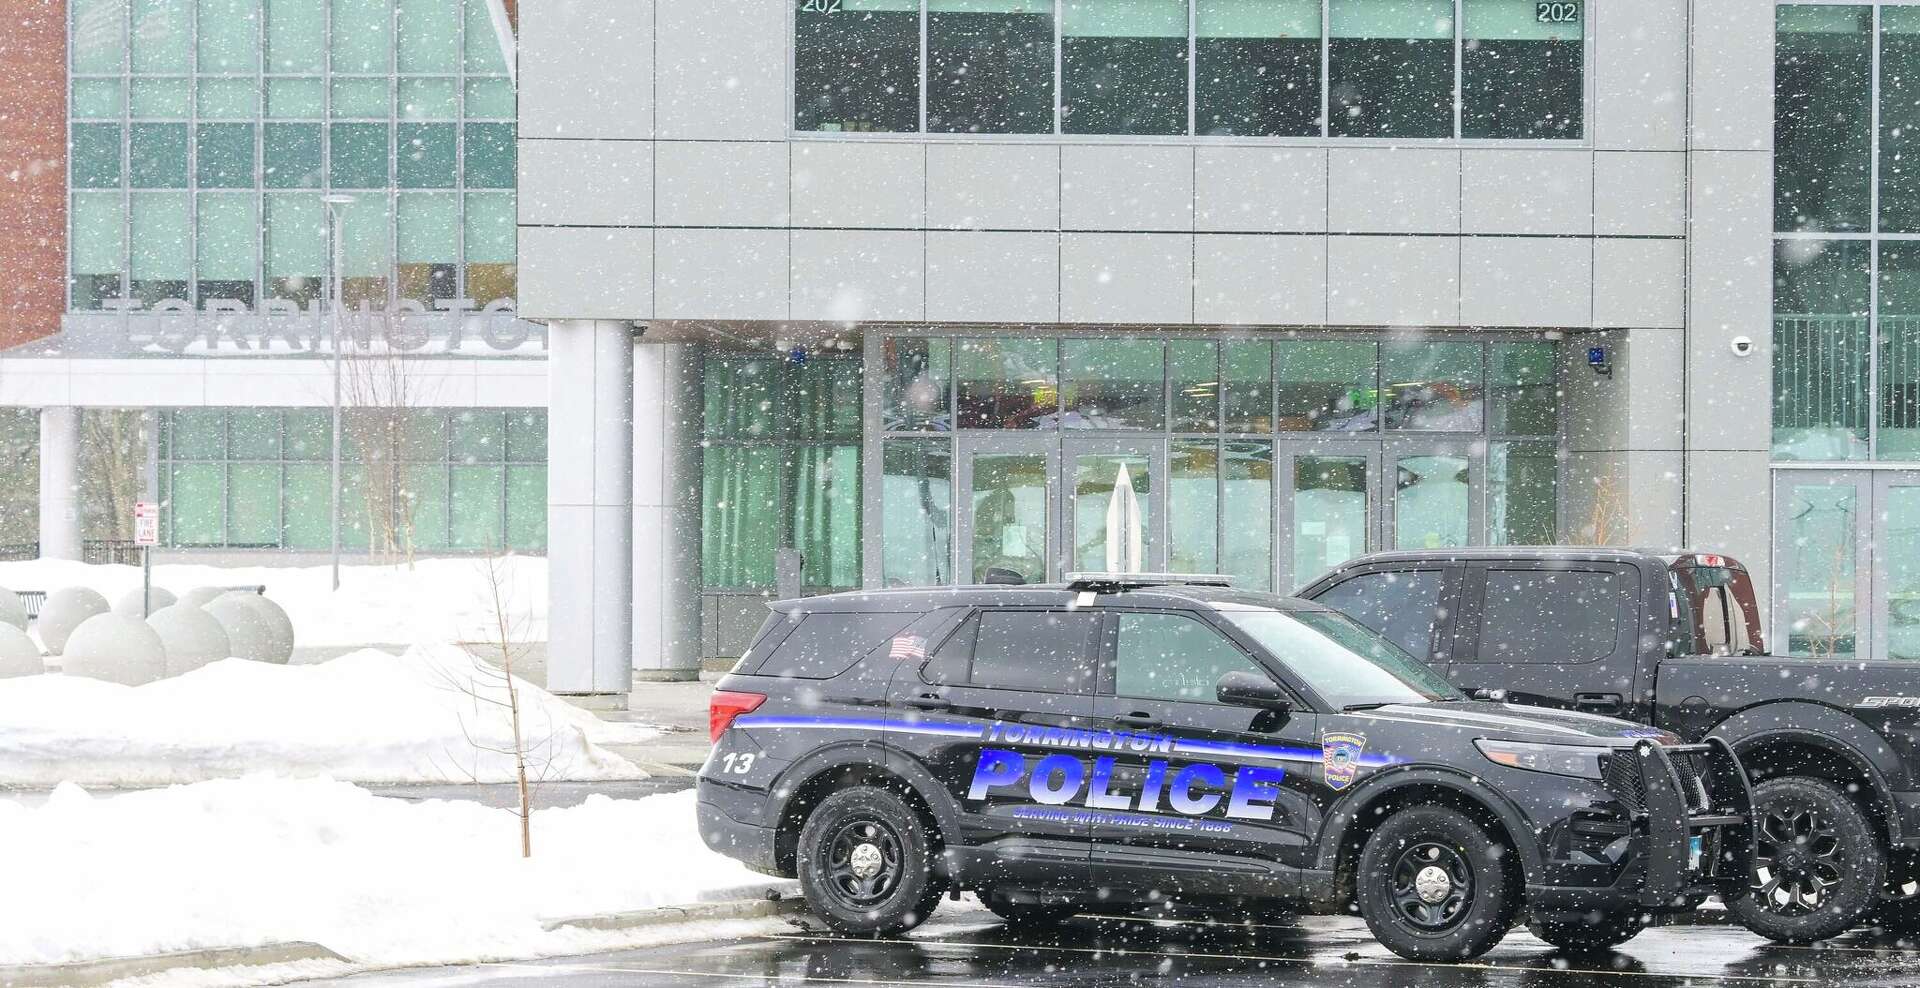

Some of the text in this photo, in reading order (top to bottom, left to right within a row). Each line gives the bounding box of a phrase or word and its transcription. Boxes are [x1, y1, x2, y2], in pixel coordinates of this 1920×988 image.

[803, 0, 841, 11] 202
[1538, 3, 1577, 21] 202
[101, 297, 549, 351] TORRINGTO
[1853, 696, 1920, 709] SPO
[989, 722, 1173, 753] TORRINGTON
[722, 752, 755, 774] 13
[967, 749, 1285, 819] POLICE
[1328, 775, 1350, 783] POLICE
[1013, 806, 1069, 821] SERVING
[1110, 814, 1152, 827] PRIDE
[1152, 816, 1194, 830] SINCE
